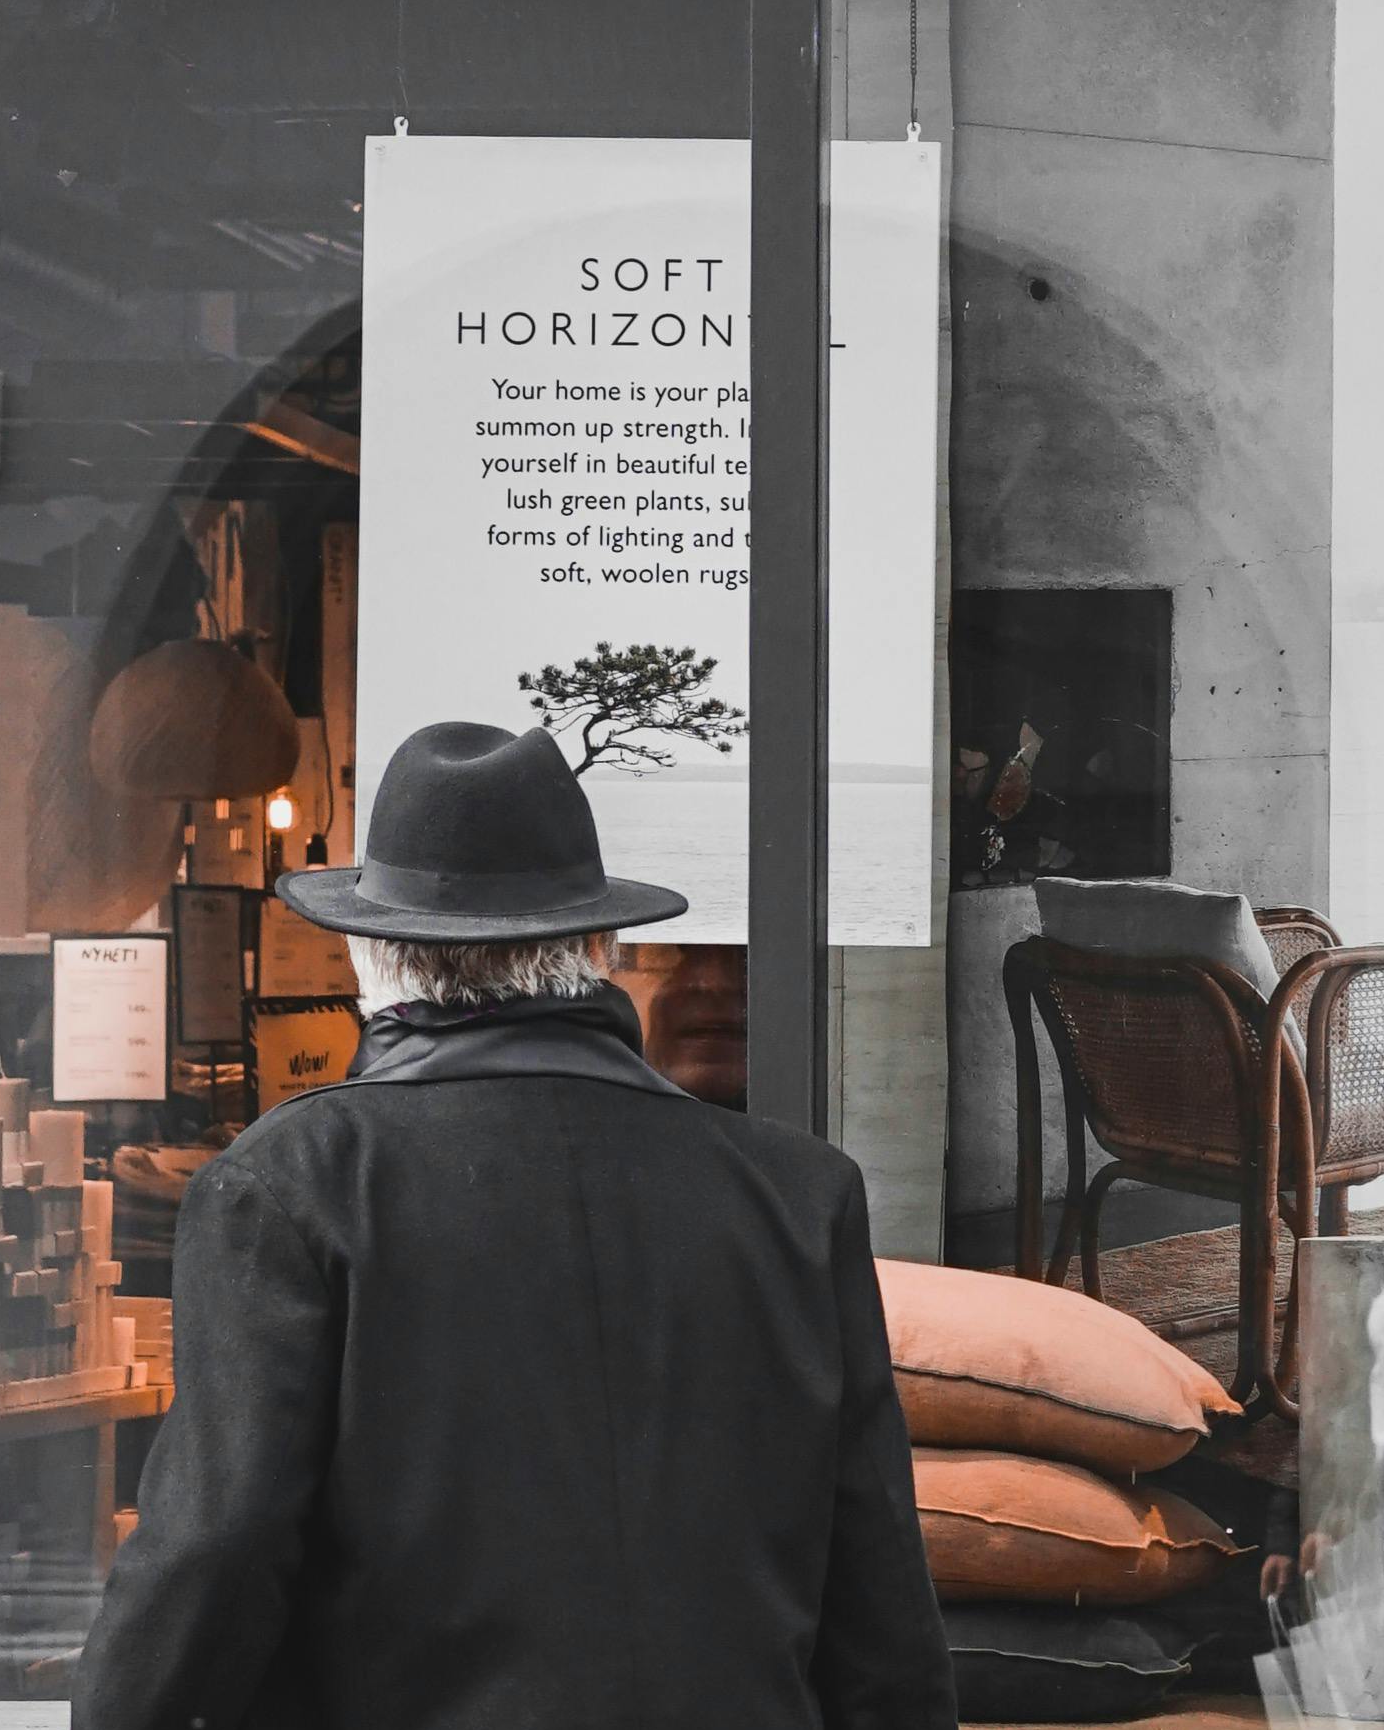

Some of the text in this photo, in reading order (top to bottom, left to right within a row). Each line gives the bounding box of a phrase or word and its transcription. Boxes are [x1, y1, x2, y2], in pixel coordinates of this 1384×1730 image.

[580, 257, 724, 292] SOFT
[457, 311, 846, 348] HORIZON
[491, 378, 751, 409] Your home is your pla
[475, 421, 576, 437] summon
[585, 422, 614, 444] up
[623, 417, 729, 445] strength.
[481, 451, 751, 479] yourself in beautiful te
[507, 487, 552, 510] lush
[560, 495, 626, 517] green
[636, 489, 711, 517] plants,
[487, 523, 557, 546] forms
[566, 524, 592, 547] of
[599, 525, 684, 554] lighting
[693, 526, 734, 548] and
[540, 561, 592, 588] soft,
[601, 562, 689, 584] woolen
